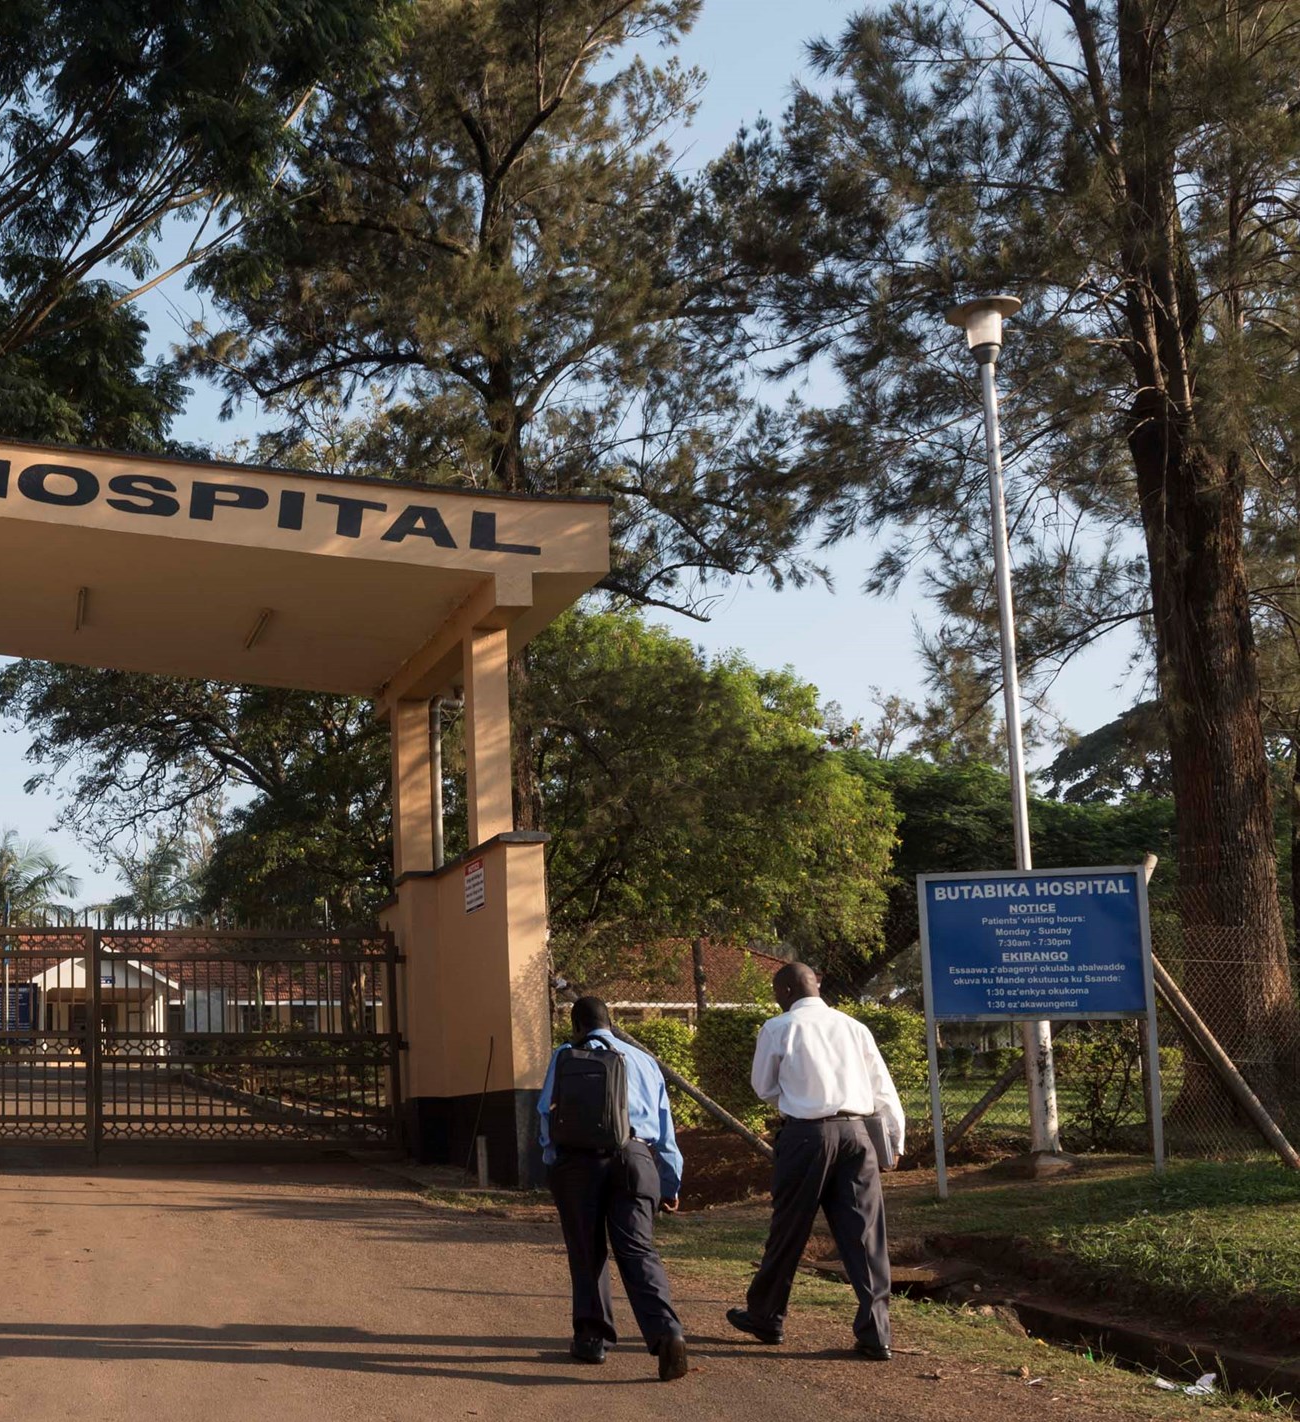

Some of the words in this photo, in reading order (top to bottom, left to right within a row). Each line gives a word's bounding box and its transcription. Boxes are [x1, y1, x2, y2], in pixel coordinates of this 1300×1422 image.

[934, 883, 1030, 900] BUTABIKA
[1036, 880, 1130, 896] HOSPITAL
[1009, 903, 1056, 913] NOTICE
[982, 916, 1020, 925] Patients'
[1022, 916, 1054, 924] visiting
[996, 928, 1030, 936] Monday
[1038, 927, 1072, 935] Sunday
[1038, 939, 1071, 947] 7:30pm
[1002, 952, 1068, 961] EKIRANGO
[990, 965, 1037, 974] z'abagenyi
[1078, 963, 1125, 971] abalwadde
[1007, 988, 1045, 997] ez'enkya
